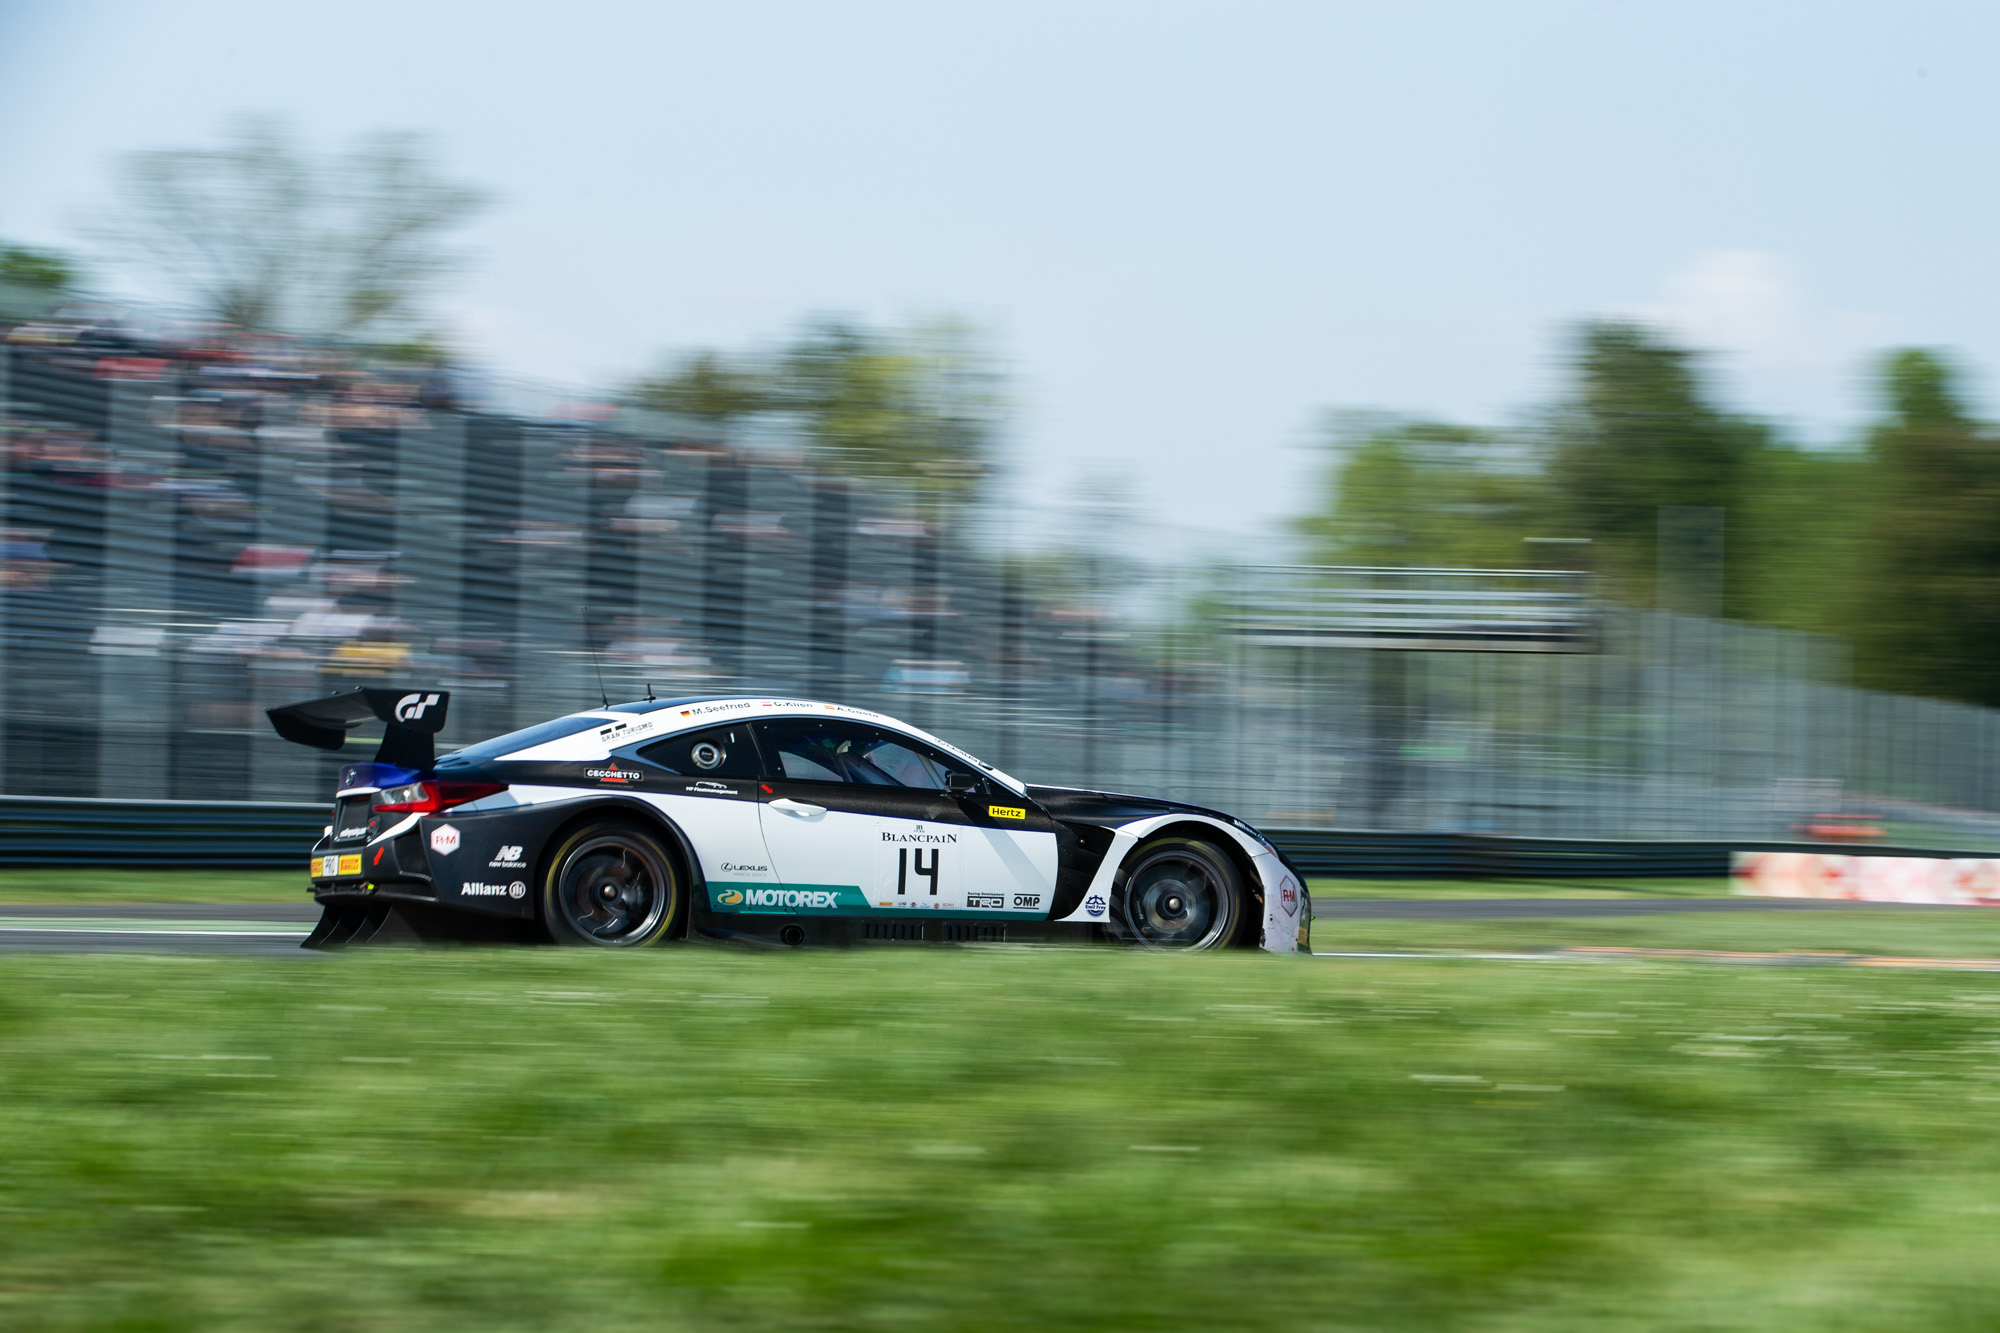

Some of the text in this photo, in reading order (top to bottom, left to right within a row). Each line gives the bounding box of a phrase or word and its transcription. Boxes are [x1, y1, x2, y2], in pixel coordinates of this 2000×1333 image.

[601, 733, 621, 742] GRAN
[622, 721, 653, 735] TURISMO
[586, 769, 641, 780] CECCHETTO
[992, 807, 1021, 818] Hertz
[501, 861, 527, 869] balance
[733, 864, 768, 872] LEXUS
[897, 848, 940, 896] 14
[460, 882, 507, 896] Allianz
[745, 888, 839, 909] MOTOREX
[1013, 896, 1040, 907] OMP
